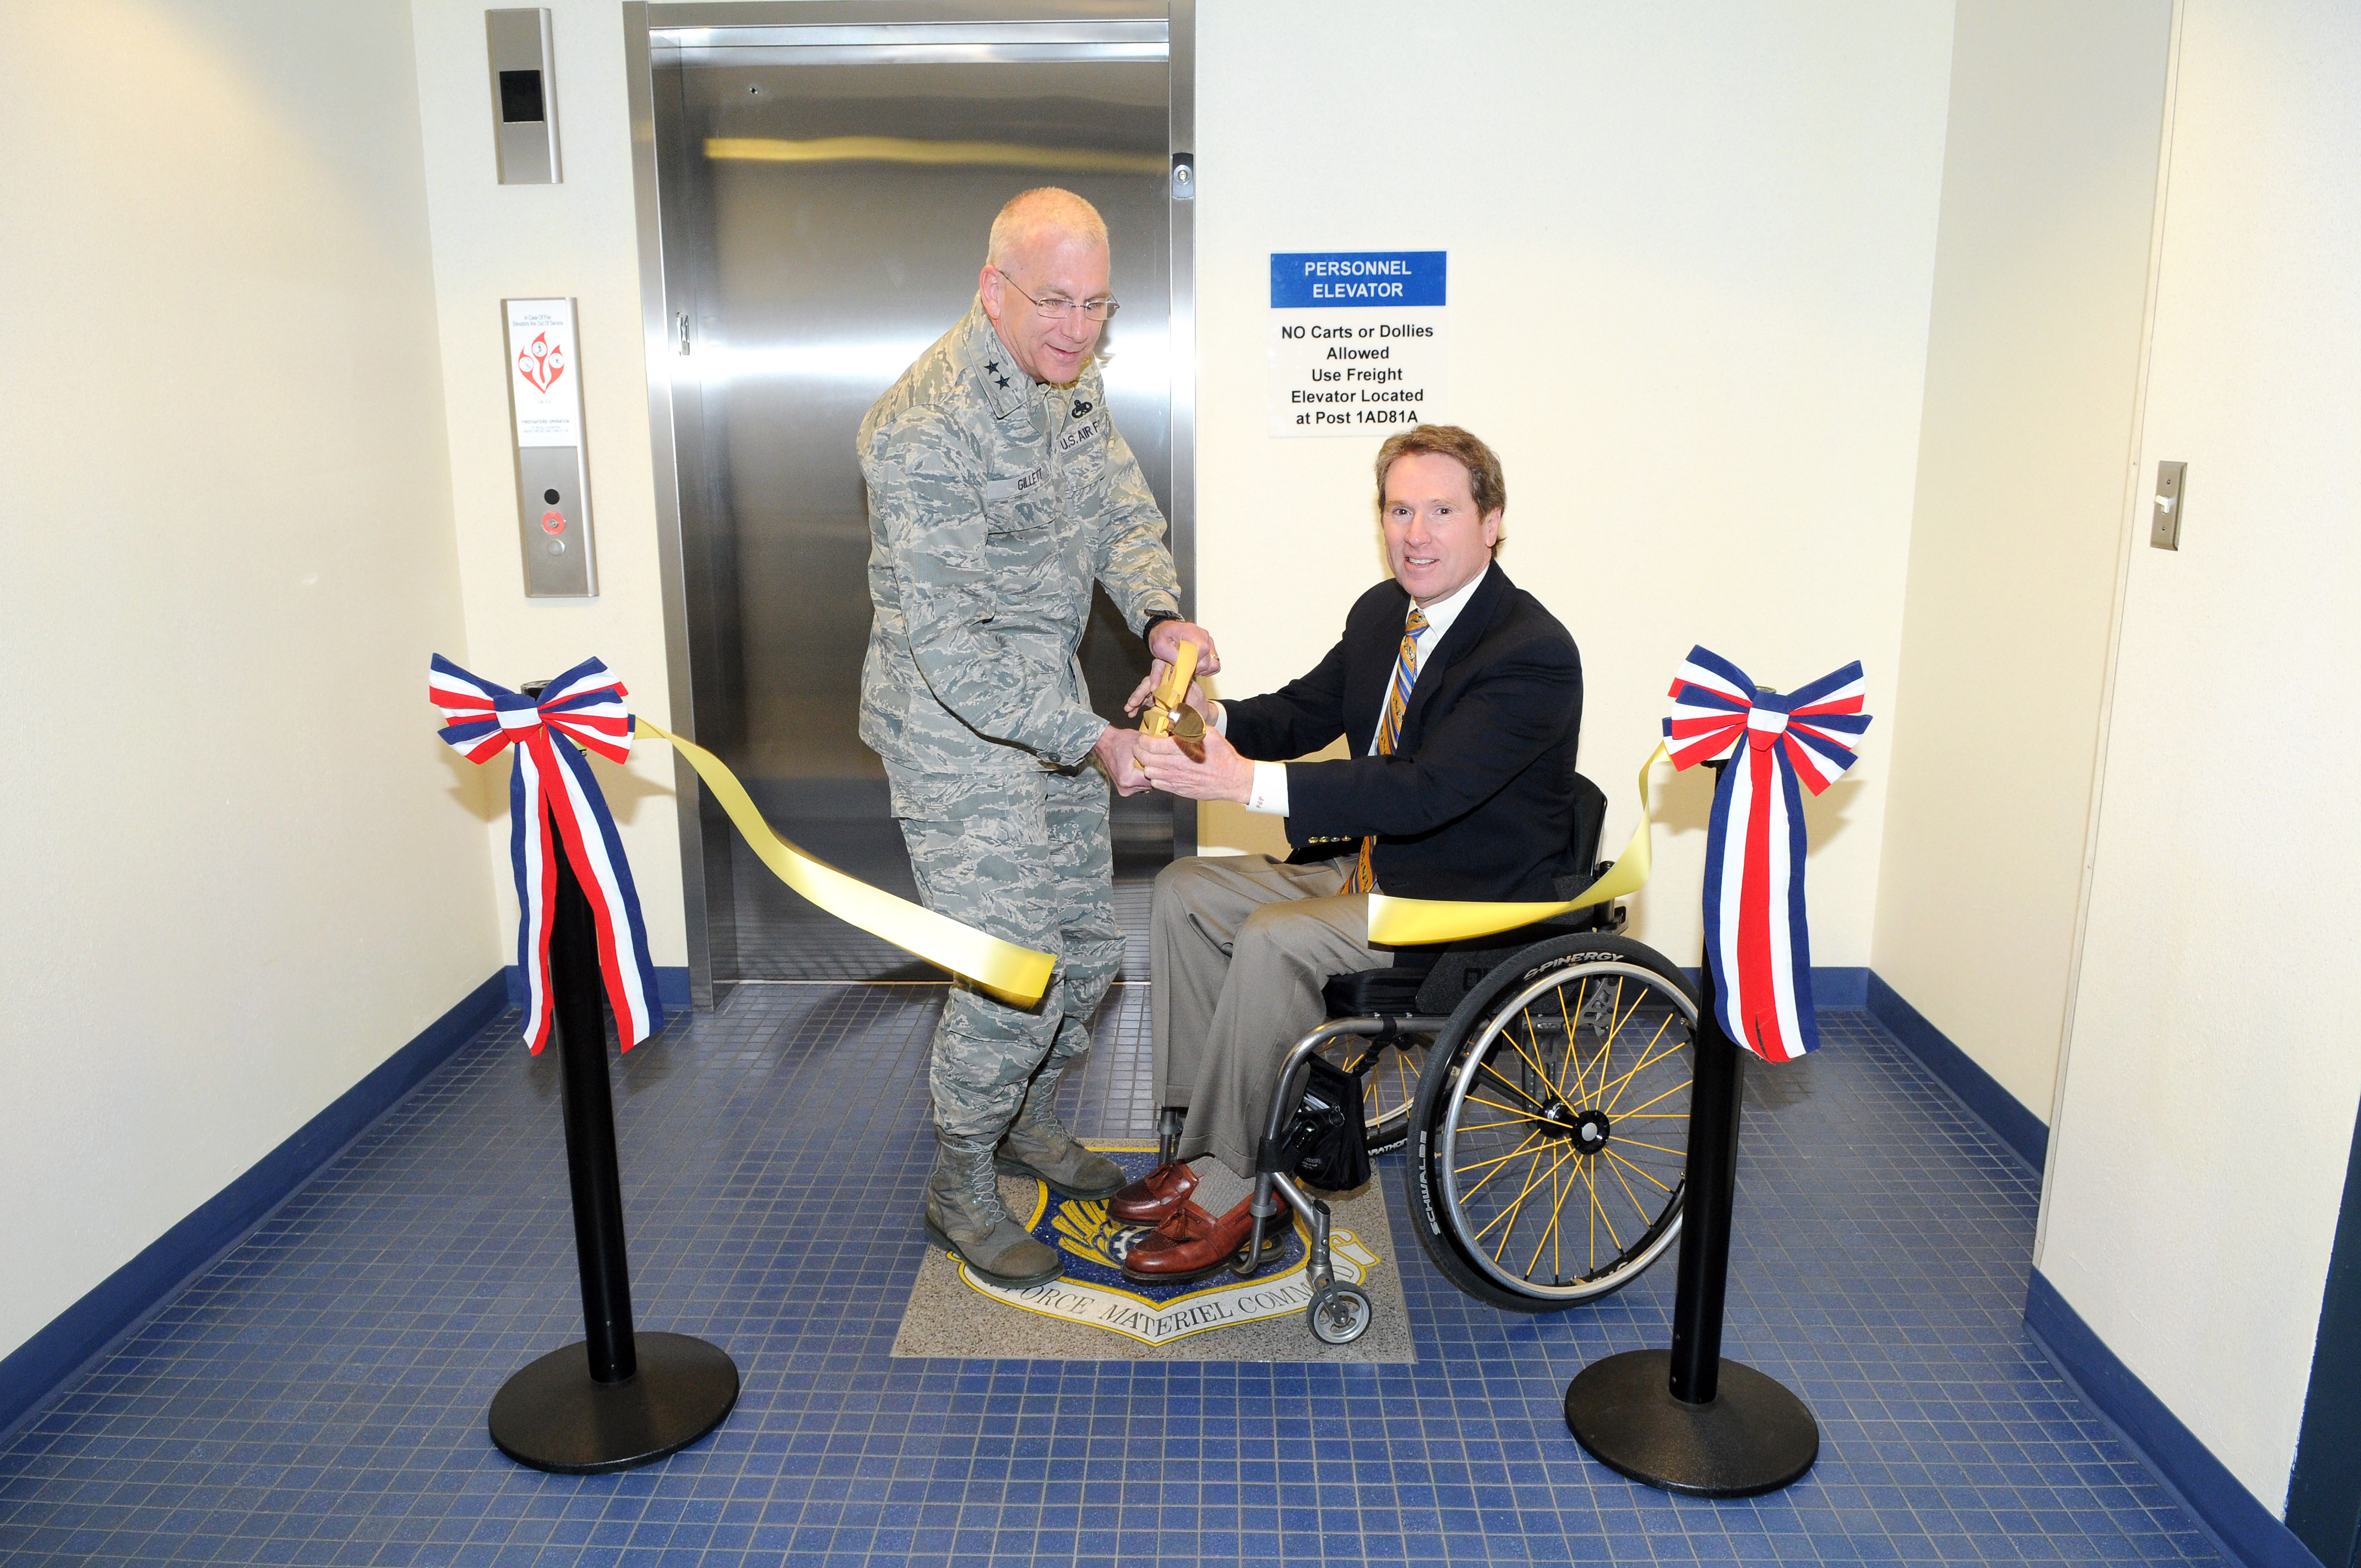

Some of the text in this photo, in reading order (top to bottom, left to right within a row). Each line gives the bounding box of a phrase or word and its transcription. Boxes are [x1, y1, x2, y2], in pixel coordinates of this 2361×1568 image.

[1305, 260, 1412, 276] PERSONNEL
[1313, 282, 1403, 298] ELEVATOR
[1282, 324, 1433, 339] NO Carts or Dollies
[1326, 346, 1389, 360] Allowed
[1312, 368, 1402, 384] Use Freight
[1292, 388, 1423, 403] Elevator Located
[1296, 410, 1418, 424] at Post 1AD81A
[1060, 420, 1100, 450] U.S. AIR F
[1018, 467, 1042, 491] GILLETT
[1524, 951, 1624, 981] SPINERGY
[1419, 1130, 1441, 1235] SCHWALBE
[1002, 1286, 1096, 1314] ORCE
[1098, 1301, 1234, 1338] MATERIEL
